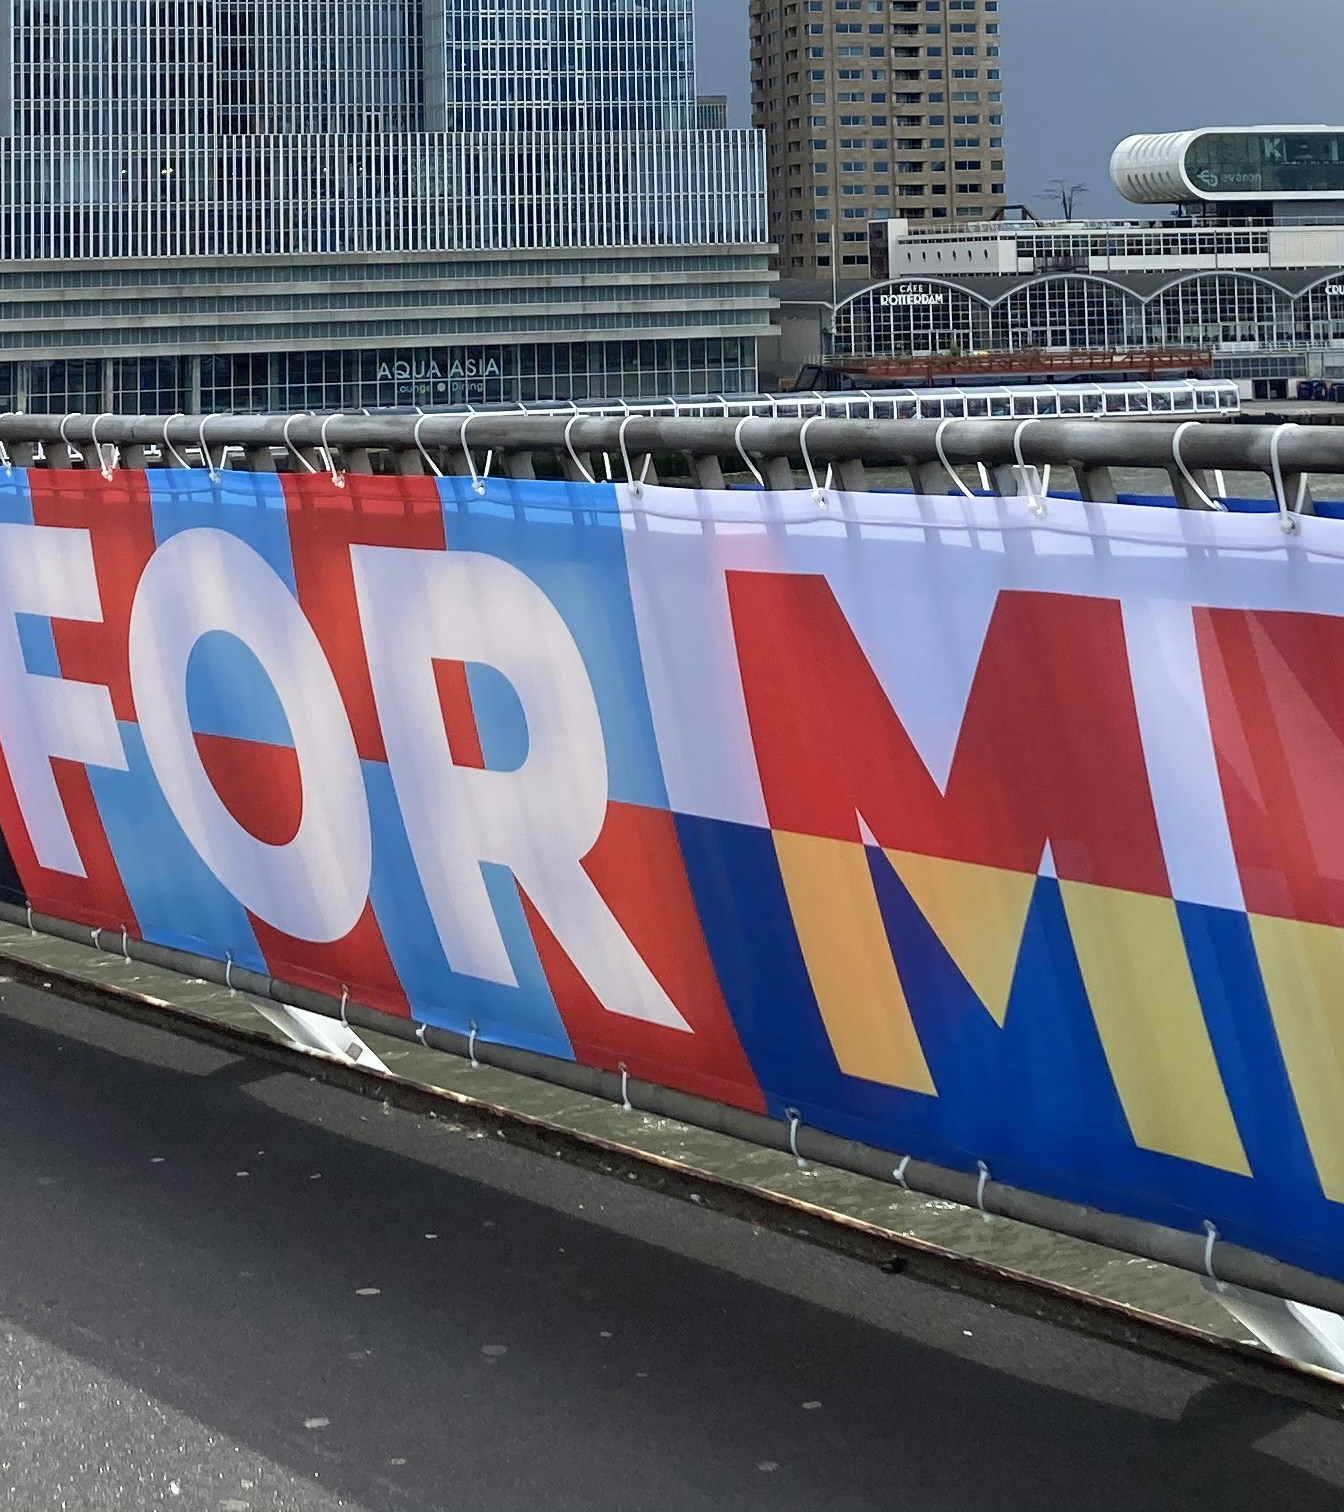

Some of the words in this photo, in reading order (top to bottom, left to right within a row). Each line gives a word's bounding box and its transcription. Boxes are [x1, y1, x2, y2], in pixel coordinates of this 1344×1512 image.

[880, 294, 944, 306] ROTTERDAM
[376, 360, 442, 380] AQUA
[449, 357, 500, 377] ASIA
